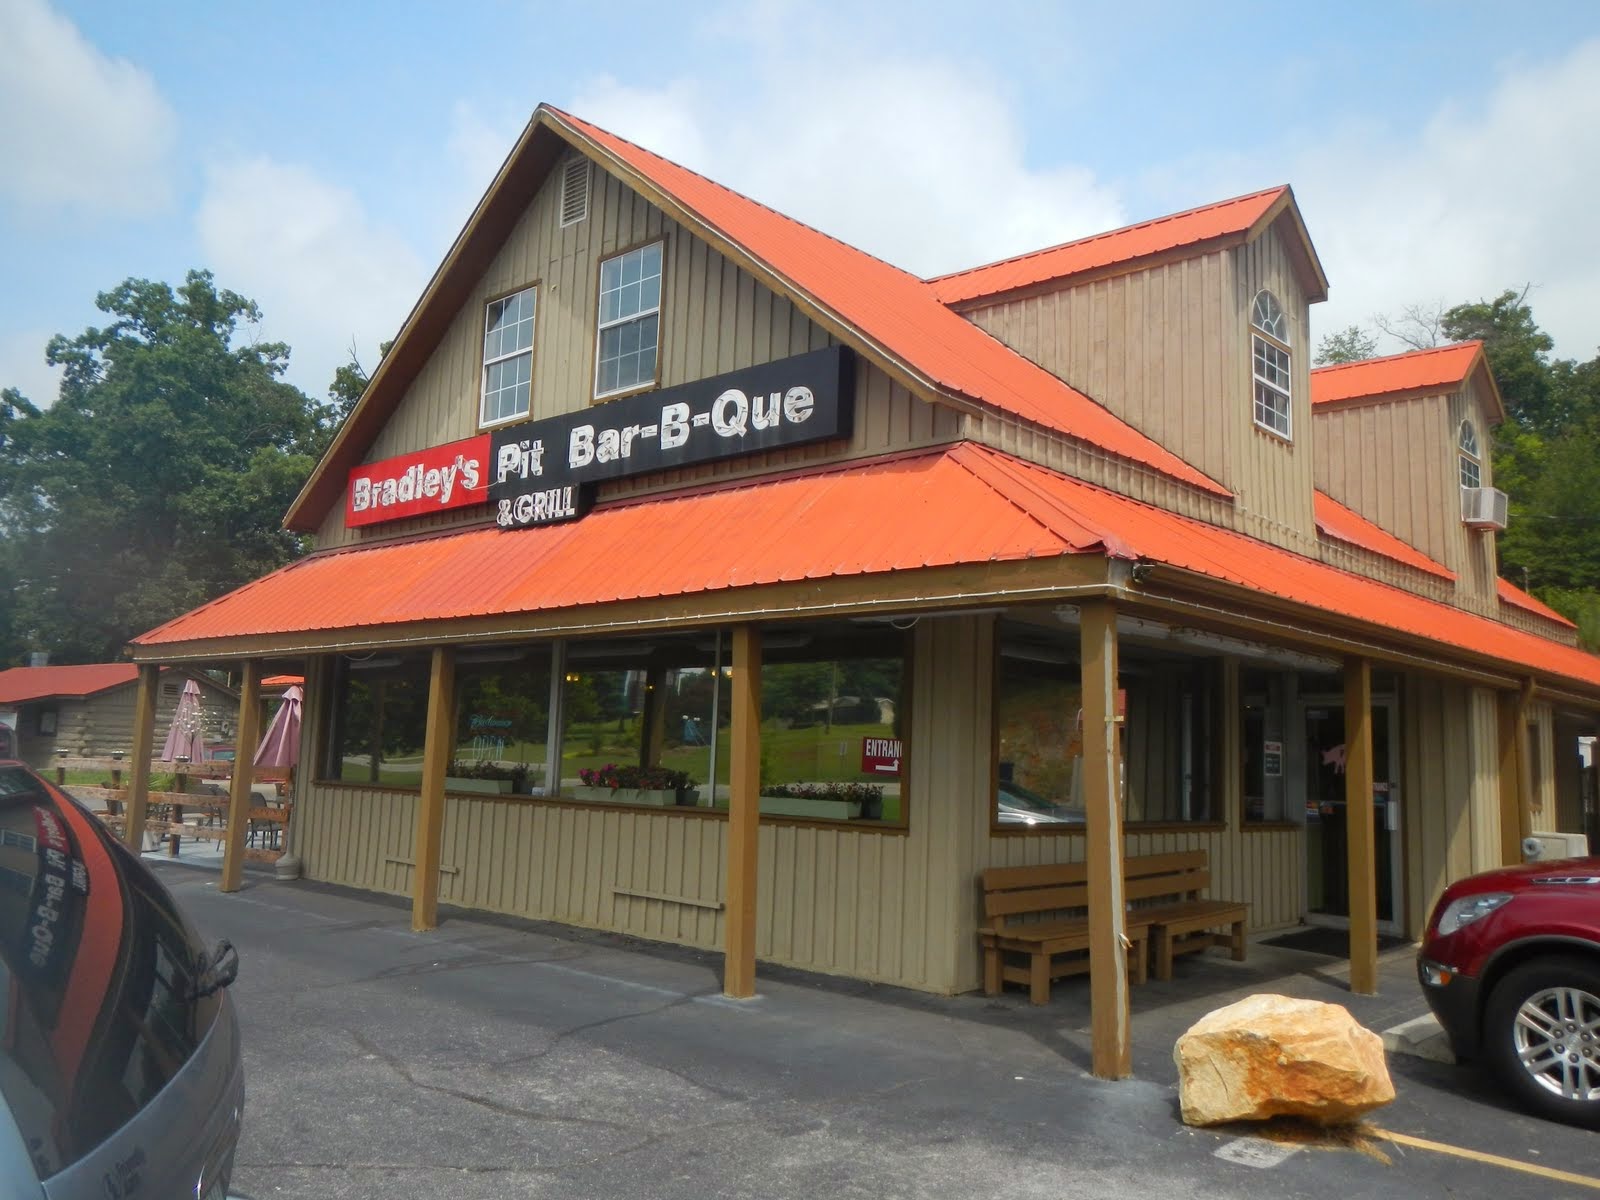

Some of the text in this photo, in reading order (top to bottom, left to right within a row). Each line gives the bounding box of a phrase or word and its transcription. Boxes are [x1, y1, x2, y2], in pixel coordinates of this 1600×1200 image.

[353, 386, 815, 512] Bradley's Pit Bar-B-Que
[496, 486, 576, 527] & GRILL
[865, 738, 903, 758] ENTRAN
